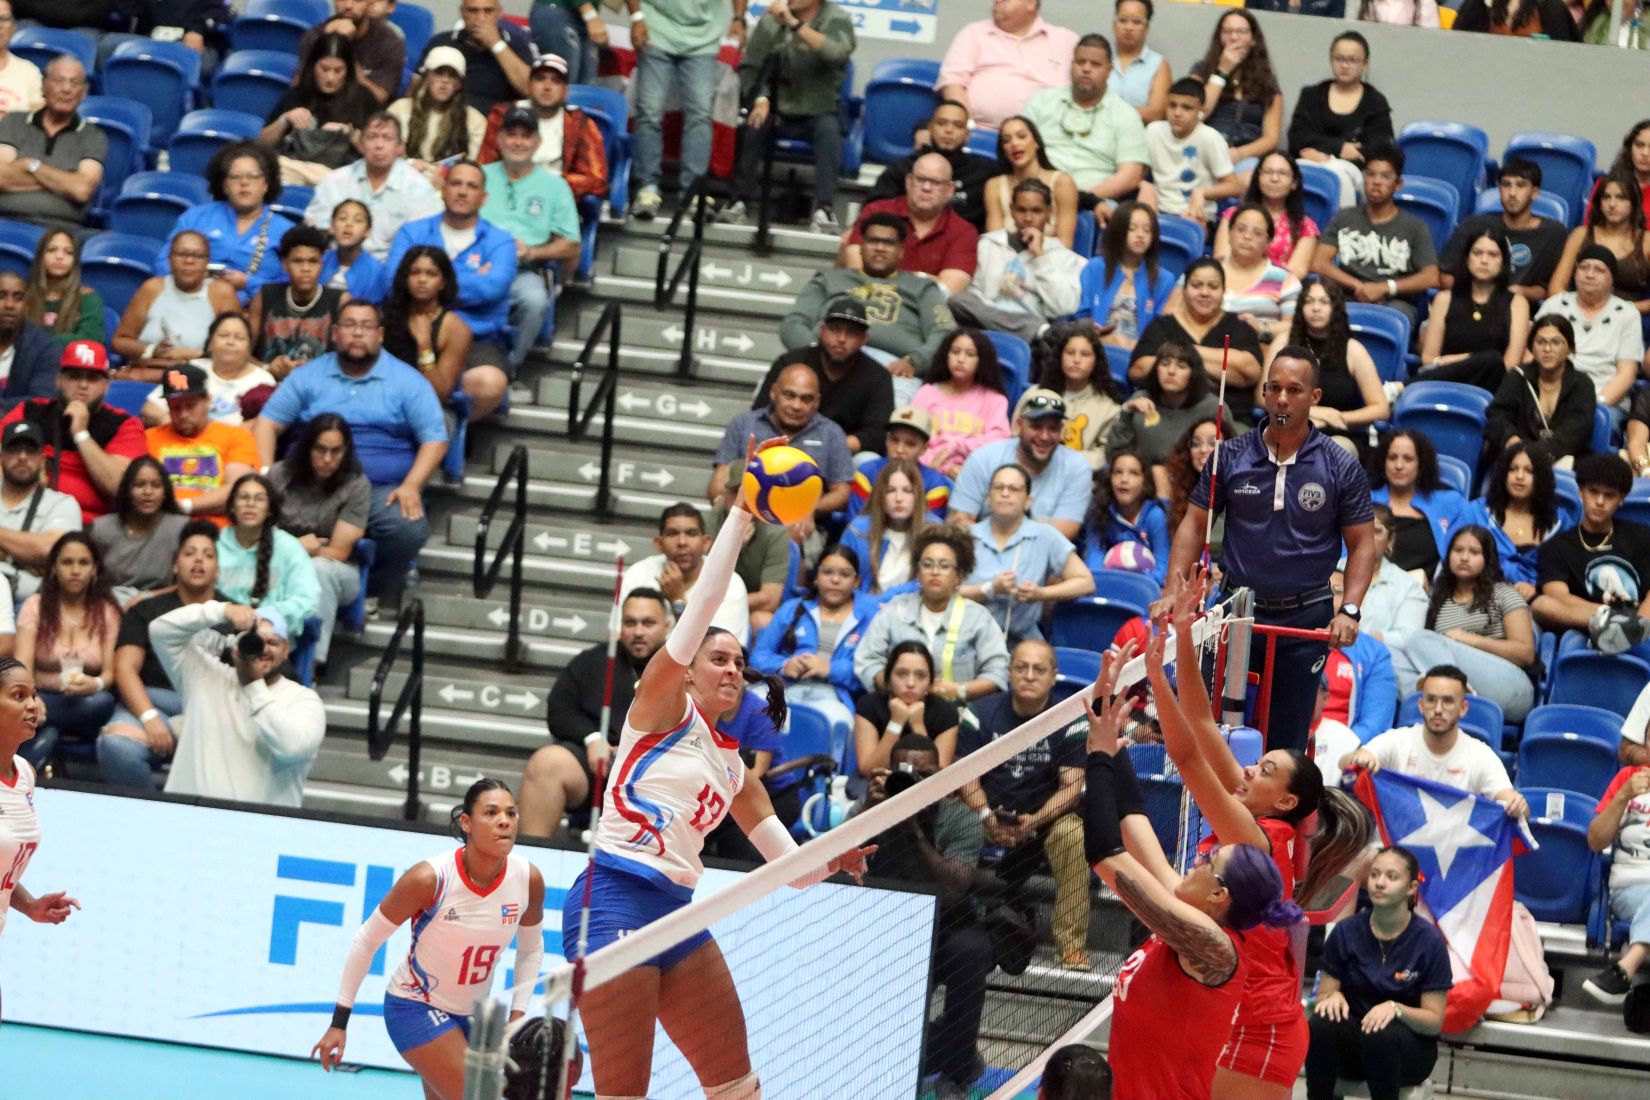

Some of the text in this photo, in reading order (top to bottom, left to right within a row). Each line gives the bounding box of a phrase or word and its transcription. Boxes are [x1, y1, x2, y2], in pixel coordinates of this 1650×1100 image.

[736, 264, 753, 285] J
[697, 328, 717, 350] H
[656, 393, 677, 416] G
[617, 463, 635, 484] F
[573, 533, 592, 555] E
[528, 608, 549, 631] D
[480, 685, 501, 708] C
[430, 766, 451, 788] B
[457, 945, 501, 986] 19
